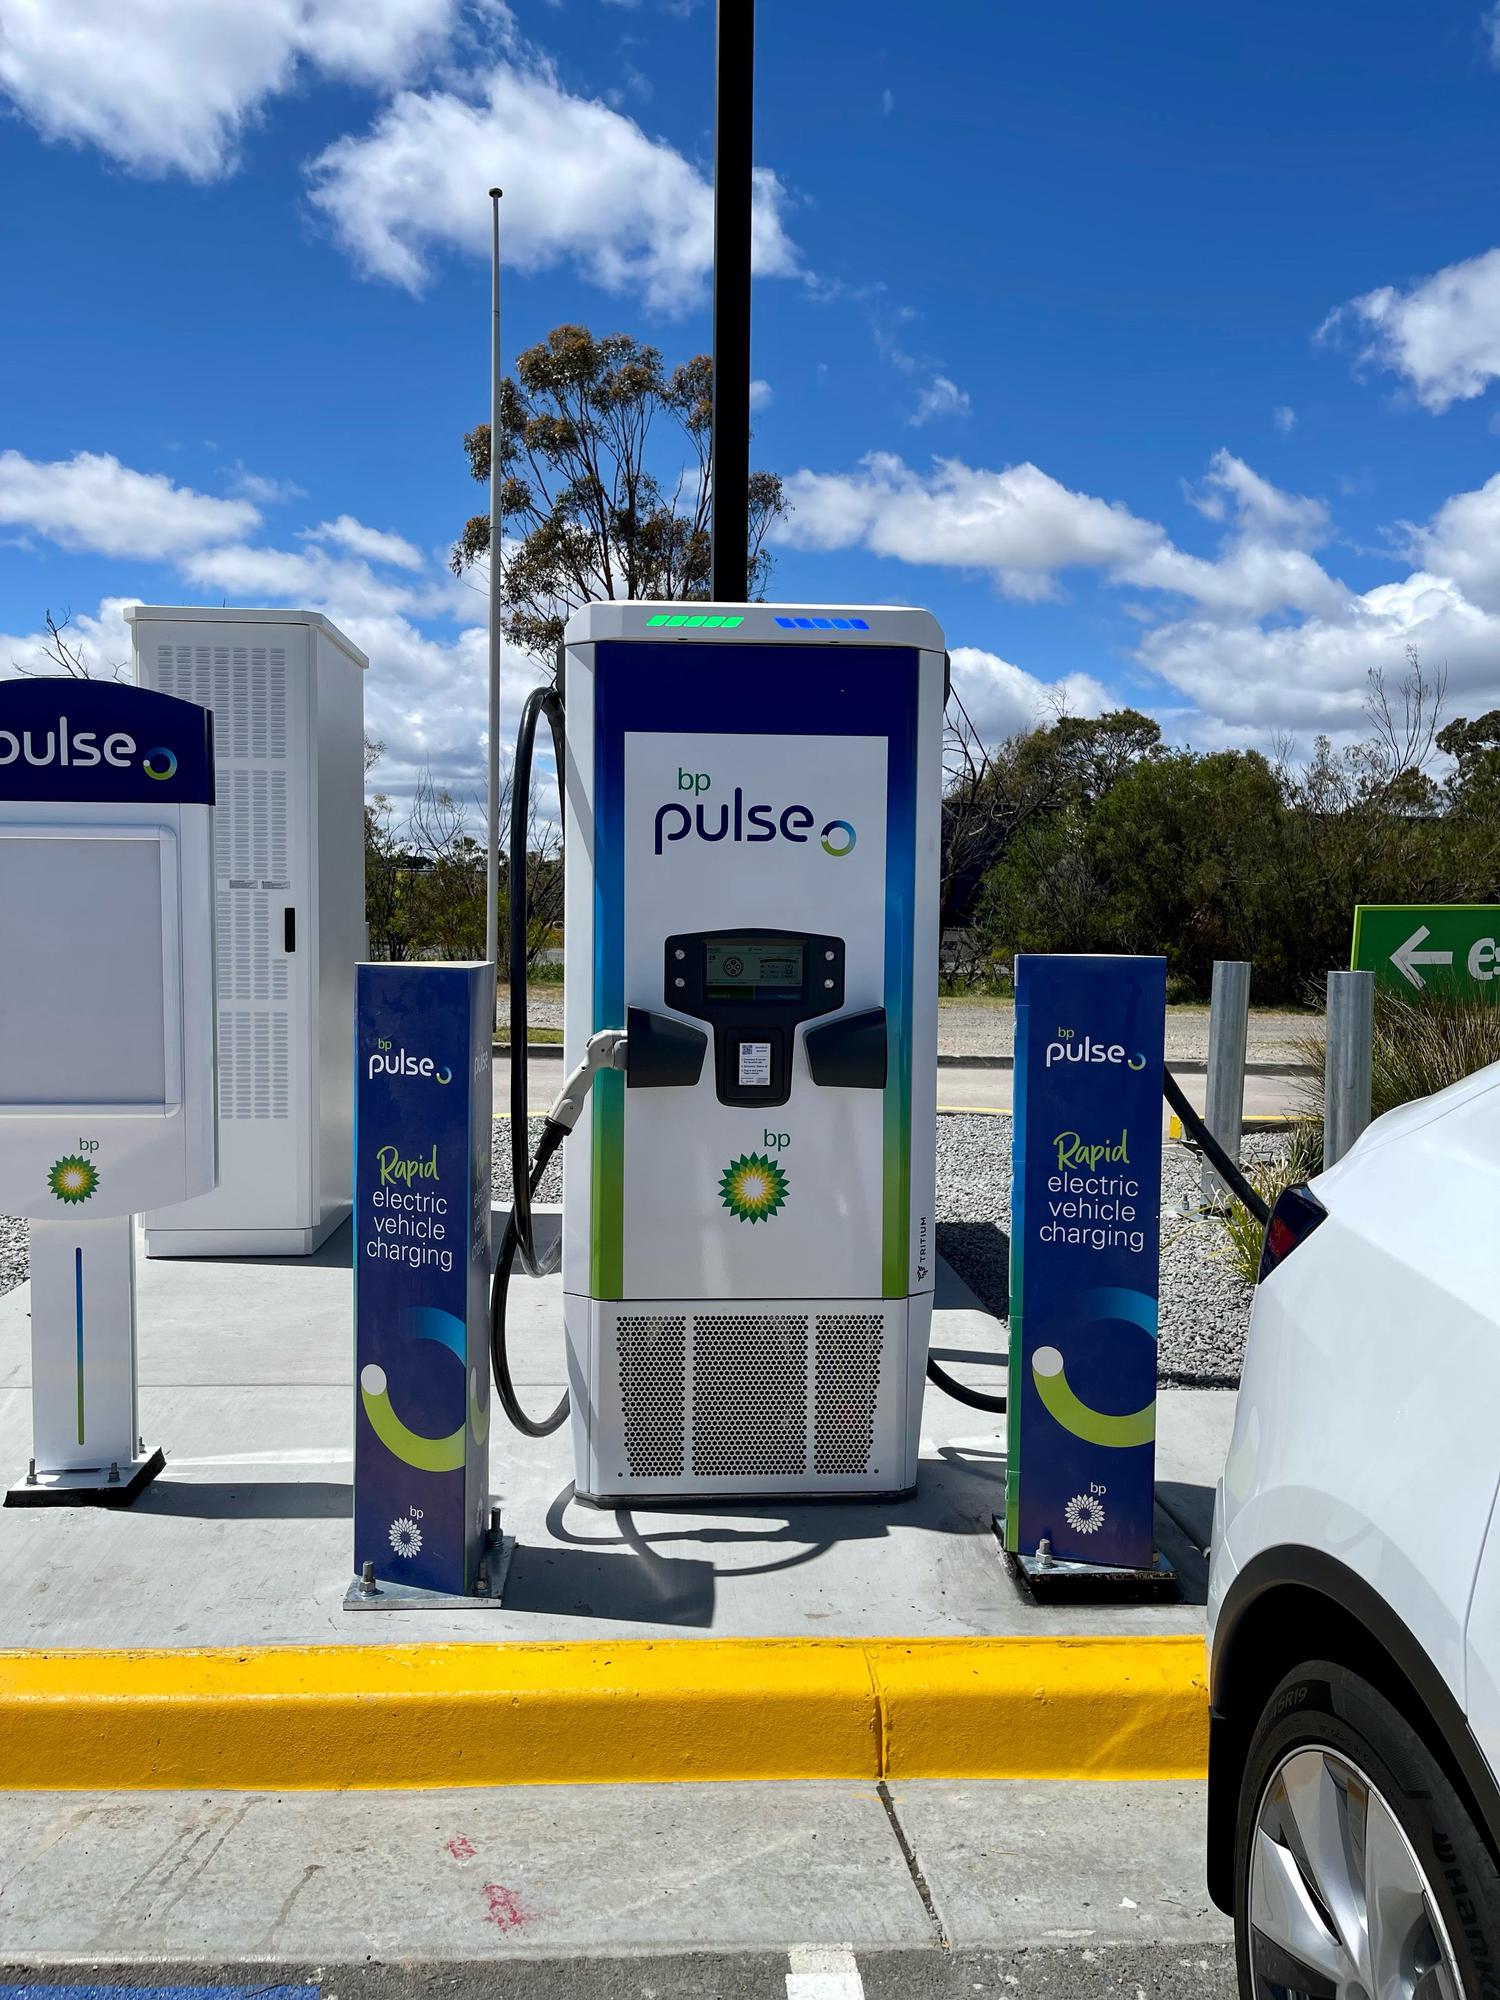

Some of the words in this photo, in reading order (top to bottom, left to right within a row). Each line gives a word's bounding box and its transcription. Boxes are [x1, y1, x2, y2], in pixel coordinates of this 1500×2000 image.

[677, 767, 712, 796] bp
[654, 787, 815, 855] pulse
[1467, 937, 1500, 981] e
[378, 1038, 392, 1051] bp
[1057, 1026, 1075, 1040] bp
[368, 1048, 435, 1080] pulse
[1046, 1035, 1126, 1067] pulse
[78, 1137, 100, 1154] bp
[763, 1128, 791, 1152] bp
[1053, 1128, 1131, 1172] Rapid
[376, 1144, 440, 1188] Rapid
[1047, 1171, 1139, 1197] electric
[372, 1186, 448, 1215] electric
[1048, 1197, 1136, 1222] vehicle
[373, 1213, 446, 1241] vehicle
[919, 1216, 927, 1264] TRITIUM
[1039, 1221, 1145, 1253] charging
[366, 1236, 454, 1273] charging
[1090, 1481, 1107, 1496] bp
[409, 1505, 424, 1520] bp
